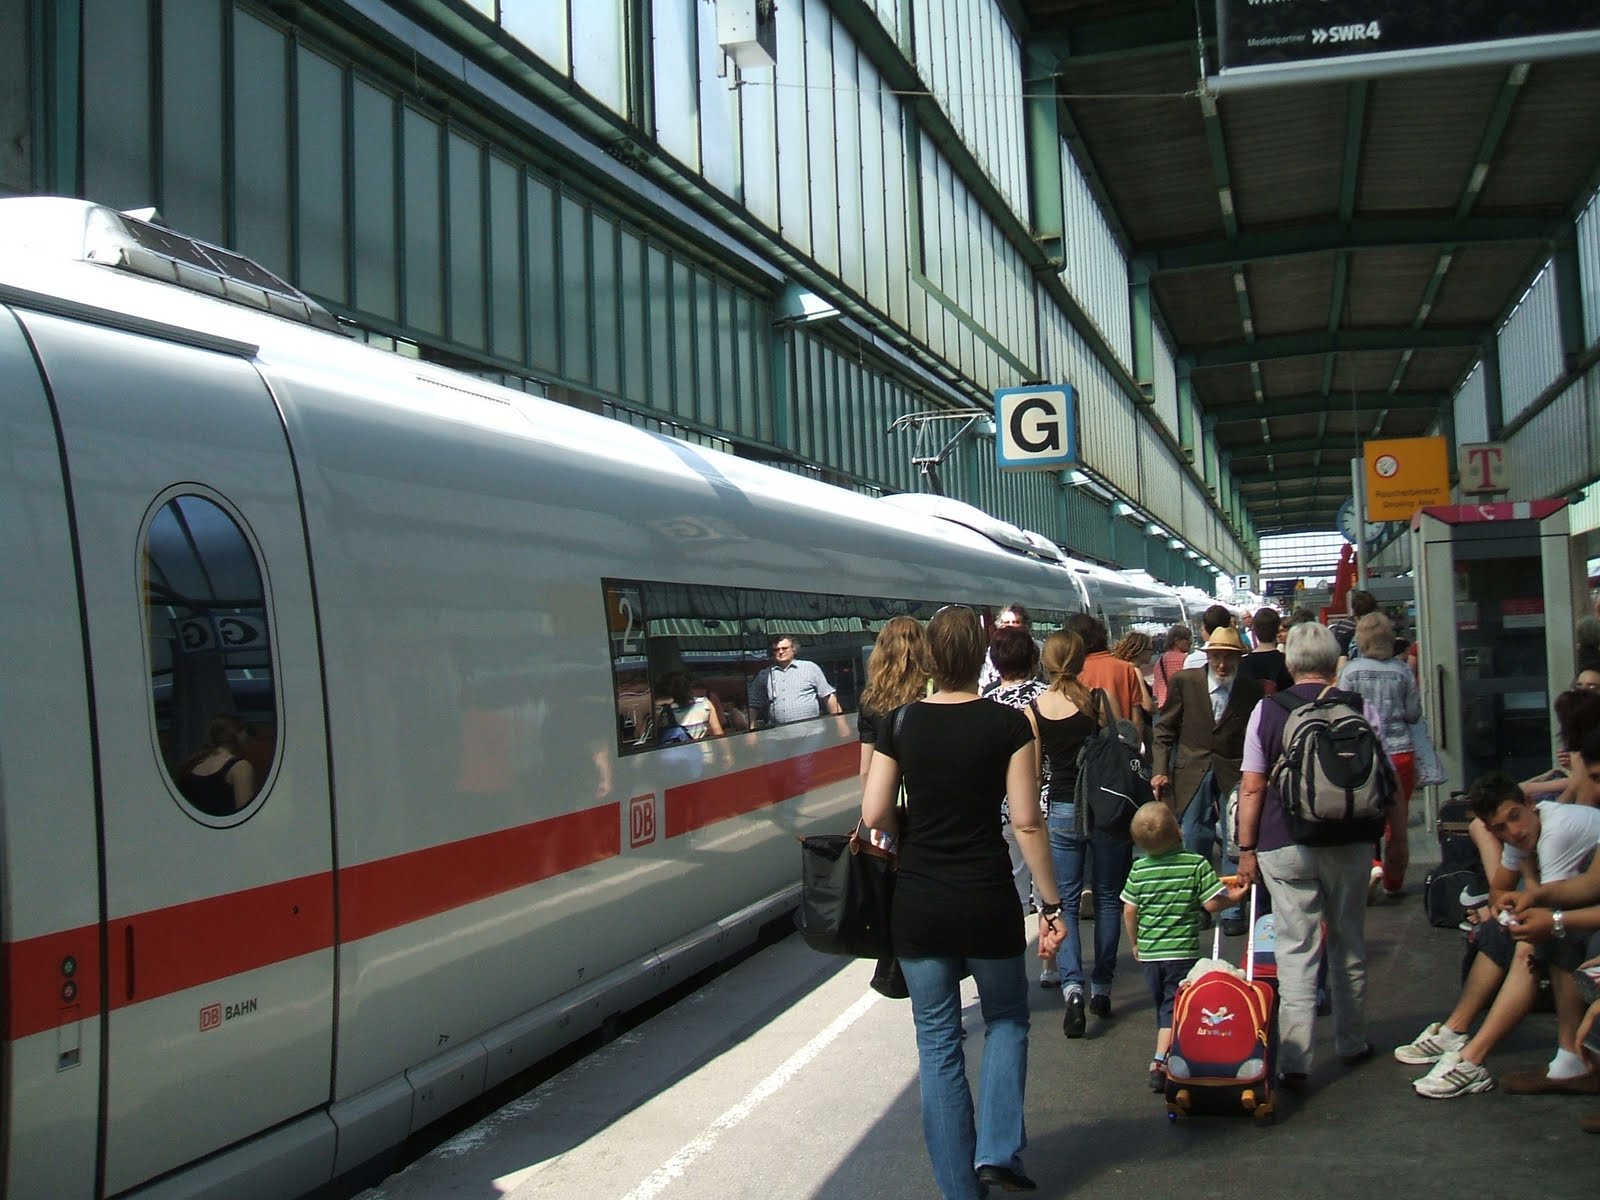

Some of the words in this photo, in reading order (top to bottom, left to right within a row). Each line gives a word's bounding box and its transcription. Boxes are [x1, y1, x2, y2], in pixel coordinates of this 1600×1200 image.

[1327, 20, 1380, 43] SWR4
[1010, 397, 1060, 453] G
[1467, 447, 1502, 488] T
[1239, 576, 1247, 589] F
[618, 597, 637, 652] 2
[631, 799, 653, 841] DB
[202, 1006, 219, 1029] DB
[225, 998, 257, 1021] BAHN
